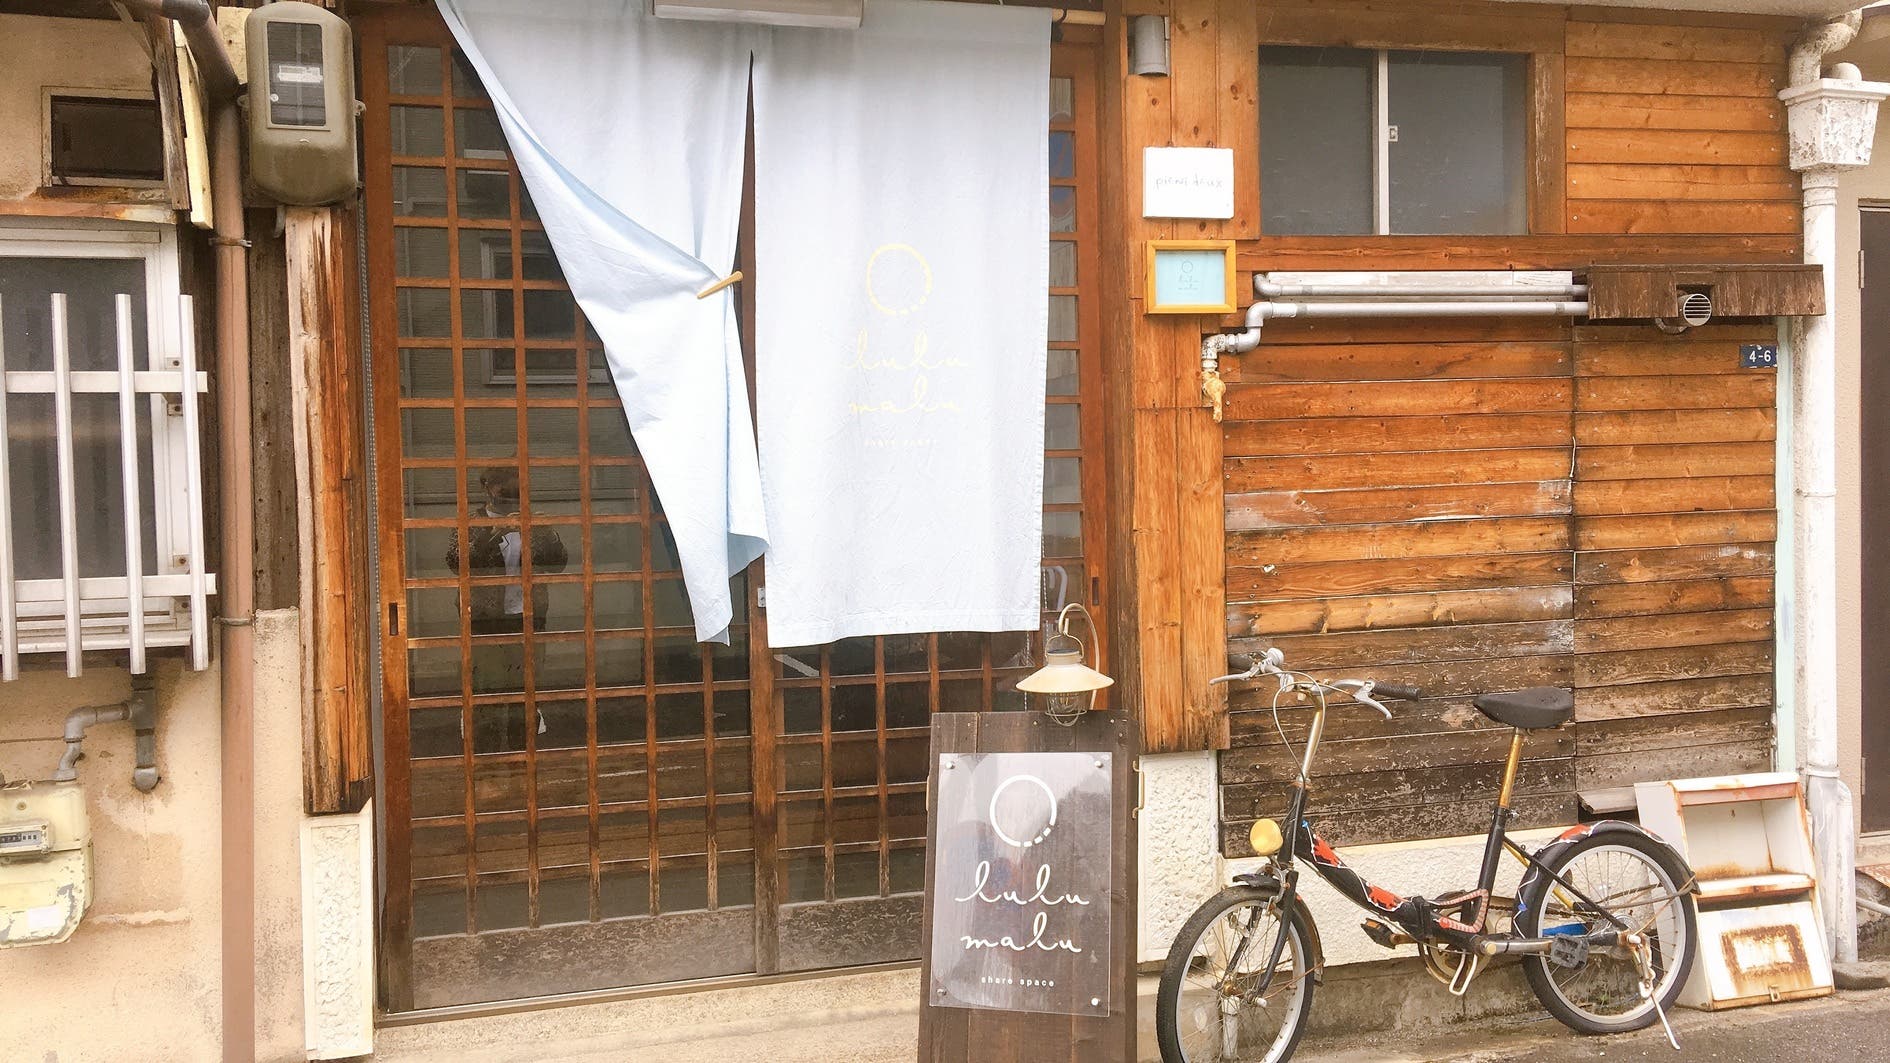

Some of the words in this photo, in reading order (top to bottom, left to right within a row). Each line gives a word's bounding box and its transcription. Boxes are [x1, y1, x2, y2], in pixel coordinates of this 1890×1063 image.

[843, 328, 968, 371] lulu
[1749, 350, 1771, 363] 4-6
[848, 375, 962, 414] malu
[955, 860, 1090, 905] lulu
[960, 911, 1082, 953] malu
[981, 975, 1013, 985] share
[1020, 978, 1054, 988] space
